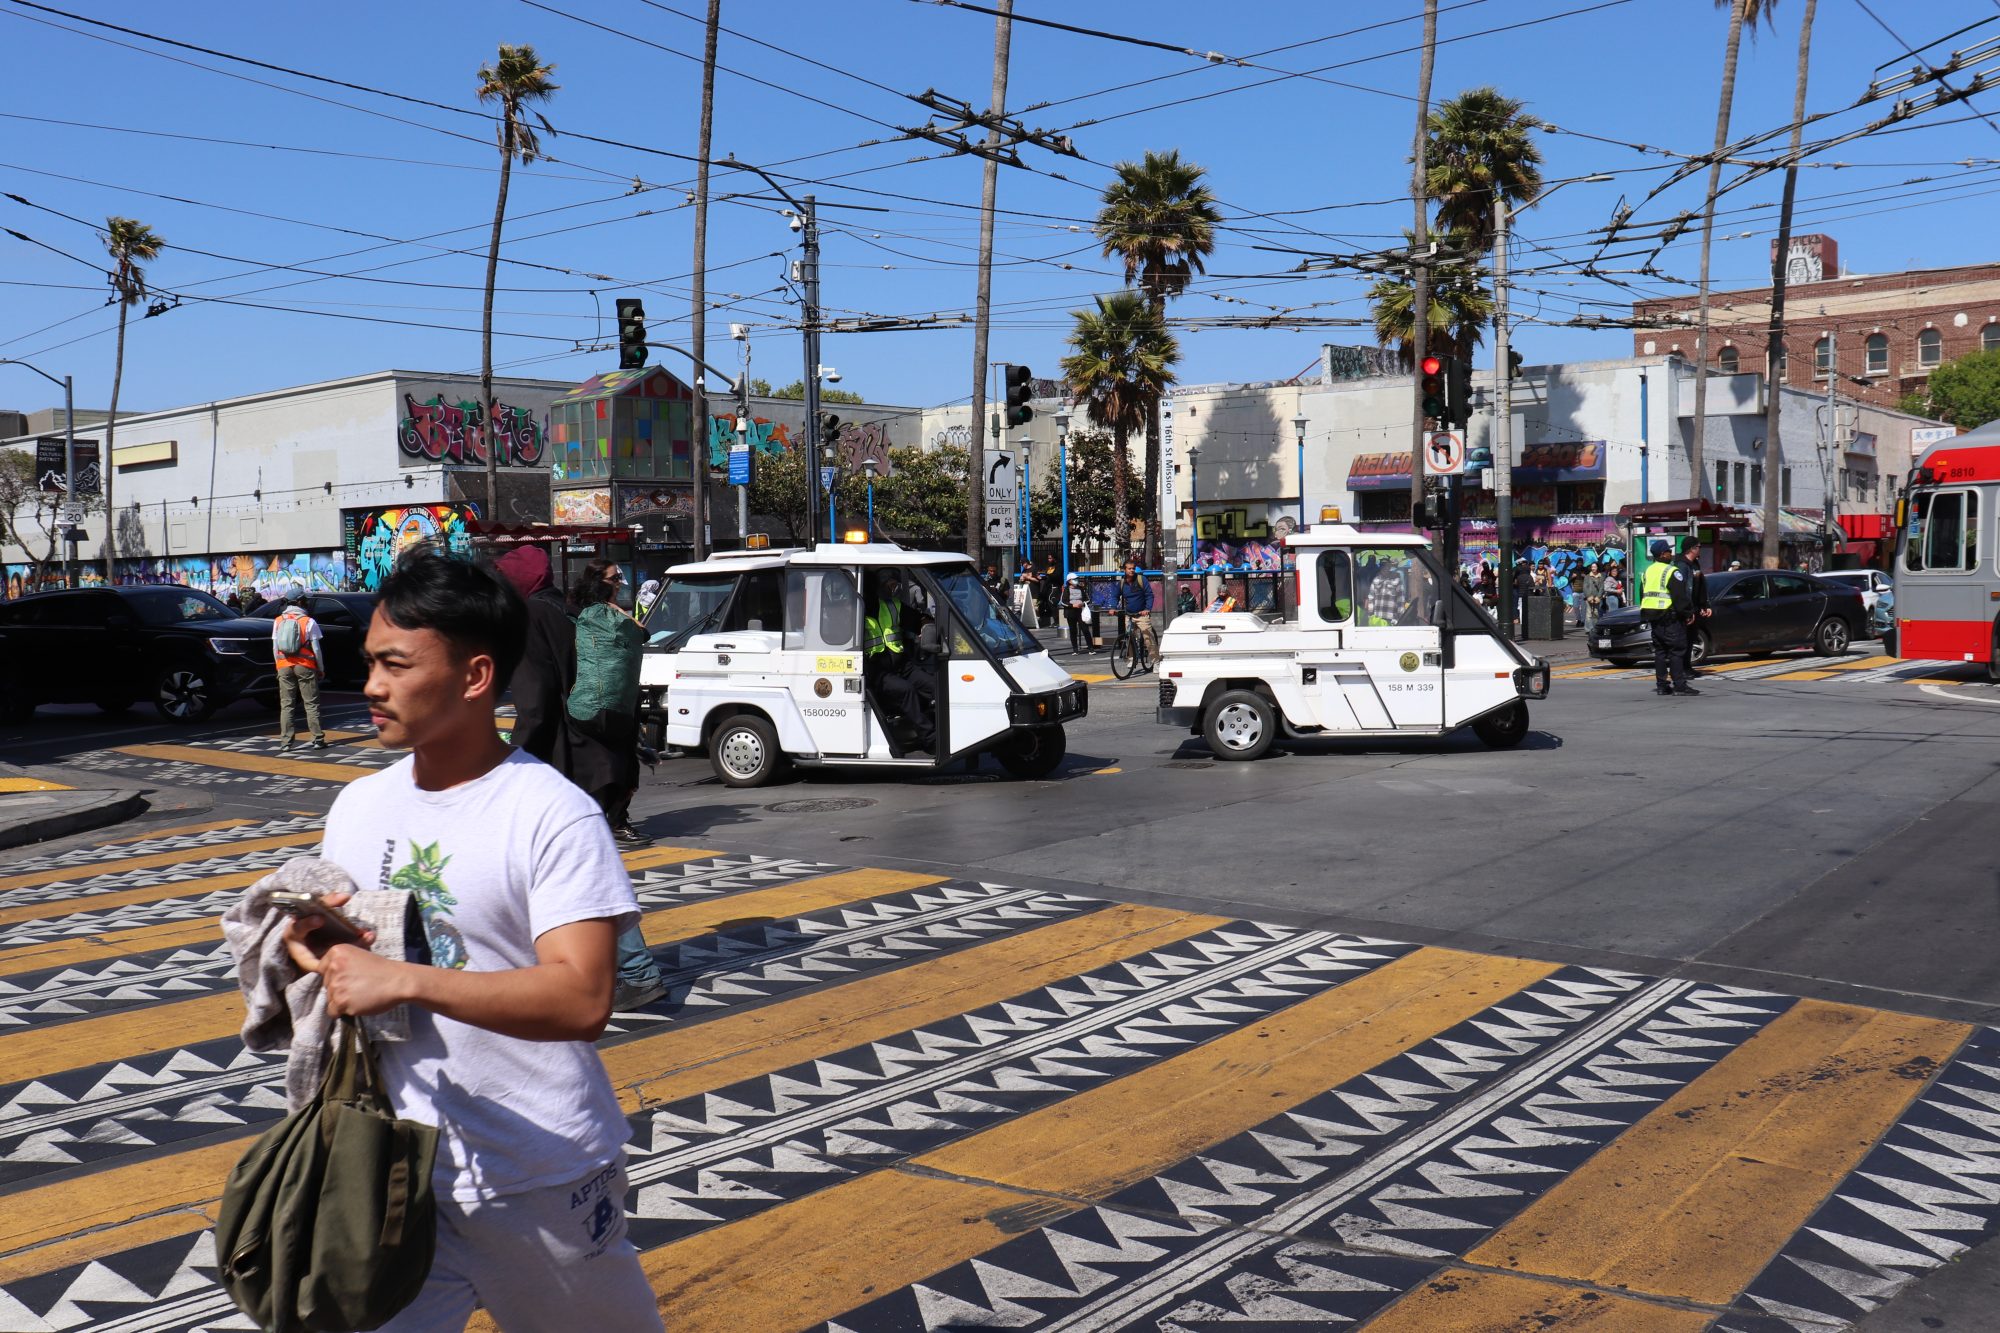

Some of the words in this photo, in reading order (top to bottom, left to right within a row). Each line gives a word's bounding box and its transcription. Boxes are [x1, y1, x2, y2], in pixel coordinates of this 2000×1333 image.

[1164, 425, 1173, 444] 16th
[1165, 447, 1173, 457] St
[1349, 451, 1414, 476] WELCO
[1165, 460, 1174, 495] Mission
[1950, 467, 1975, 478] 8810
[989, 487, 1012, 498] ONLY
[408, 507, 429, 519] CULTURAL
[990, 507, 1012, 515] EXCEPT
[67, 513, 82, 522] 20
[1388, 684, 1403, 692] 158
[1417, 684, 1434, 692] 339
[803, 708, 847, 717] 15800290
[570, 1162, 618, 1211] APTOS
